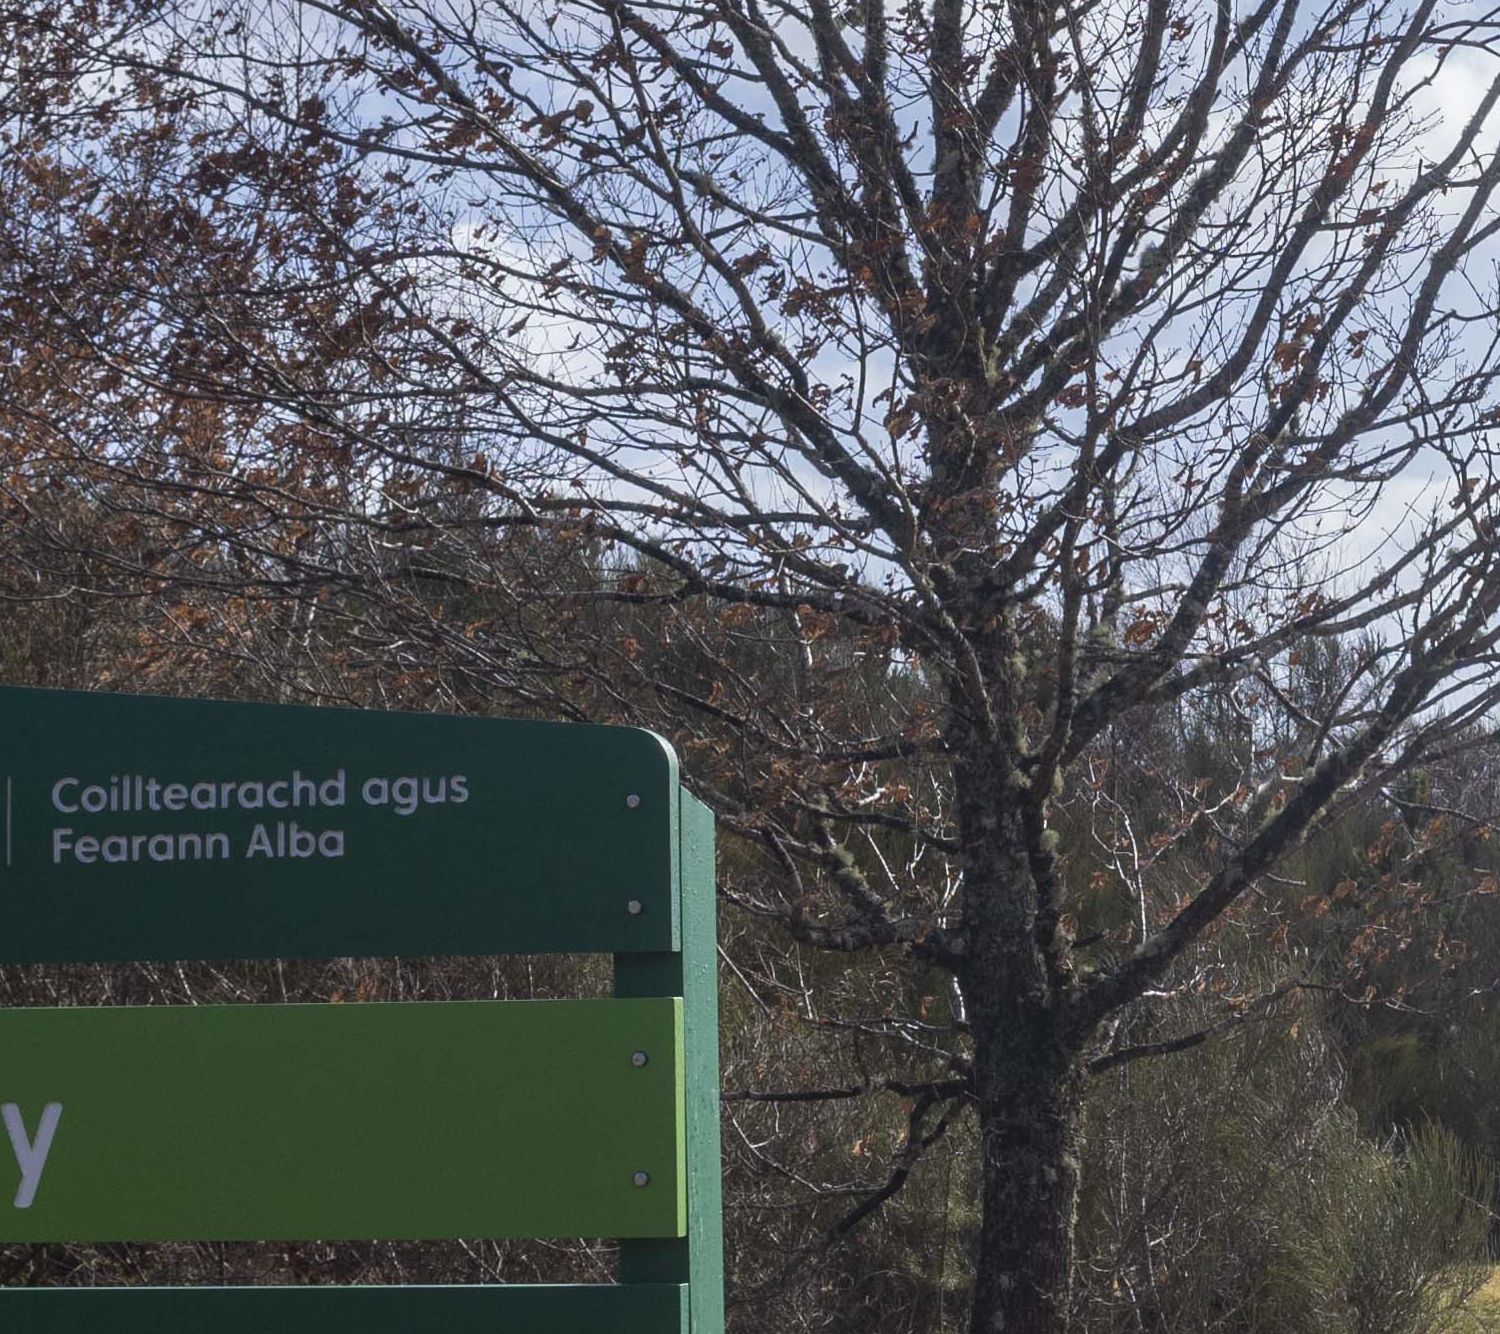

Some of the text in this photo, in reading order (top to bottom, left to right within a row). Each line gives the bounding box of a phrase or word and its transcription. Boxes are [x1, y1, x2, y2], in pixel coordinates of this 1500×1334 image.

[52, 769, 469, 816] Coilltearachd agus
[52, 822, 345, 864] Fearann Alba
